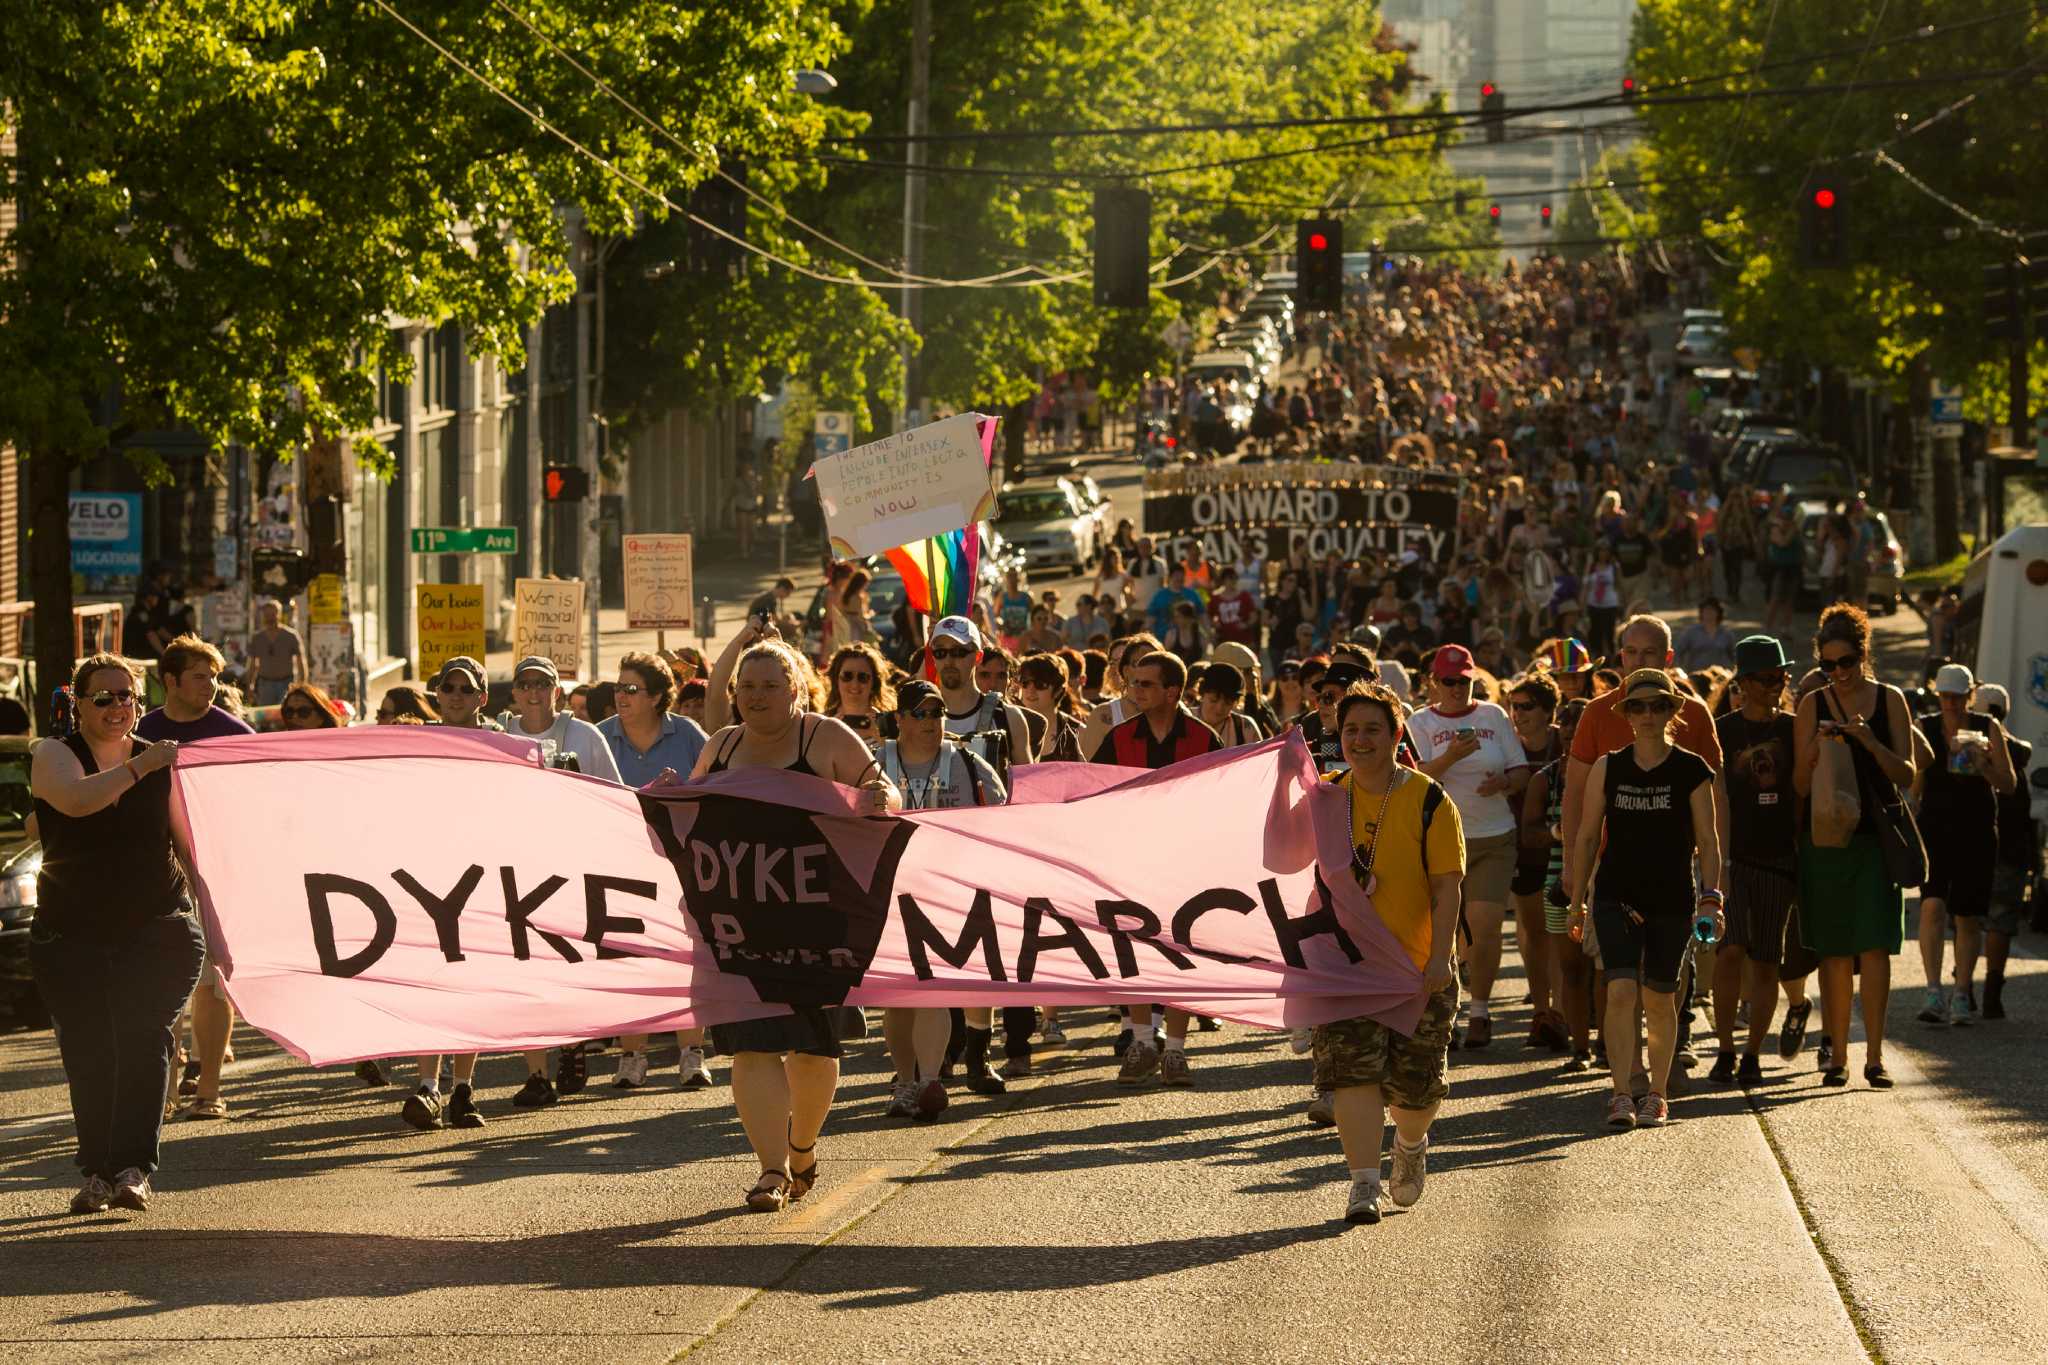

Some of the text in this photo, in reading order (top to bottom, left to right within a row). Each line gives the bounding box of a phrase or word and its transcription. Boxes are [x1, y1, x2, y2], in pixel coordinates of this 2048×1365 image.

[862, 439, 892, 457] TIME
[900, 432, 914, 446] TO
[873, 496, 918, 520] NOW
[1191, 489, 1411, 526] ONWARD TO
[416, 530, 512, 551] 11th Ave
[76, 551, 141, 567] LOCATION
[421, 592, 445, 608] Our
[520, 588, 573, 607] War is
[421, 616, 446, 631] Our
[422, 640, 443, 654] Our
[518, 626, 576, 647] Dykes are
[519, 643, 574, 666] Flous
[1615, 793, 1672, 810] DRUMLINE
[691, 839, 830, 904] DYKE
[304, 863, 1365, 983] DYKE MARCH
[711, 912, 861, 969] PWER
